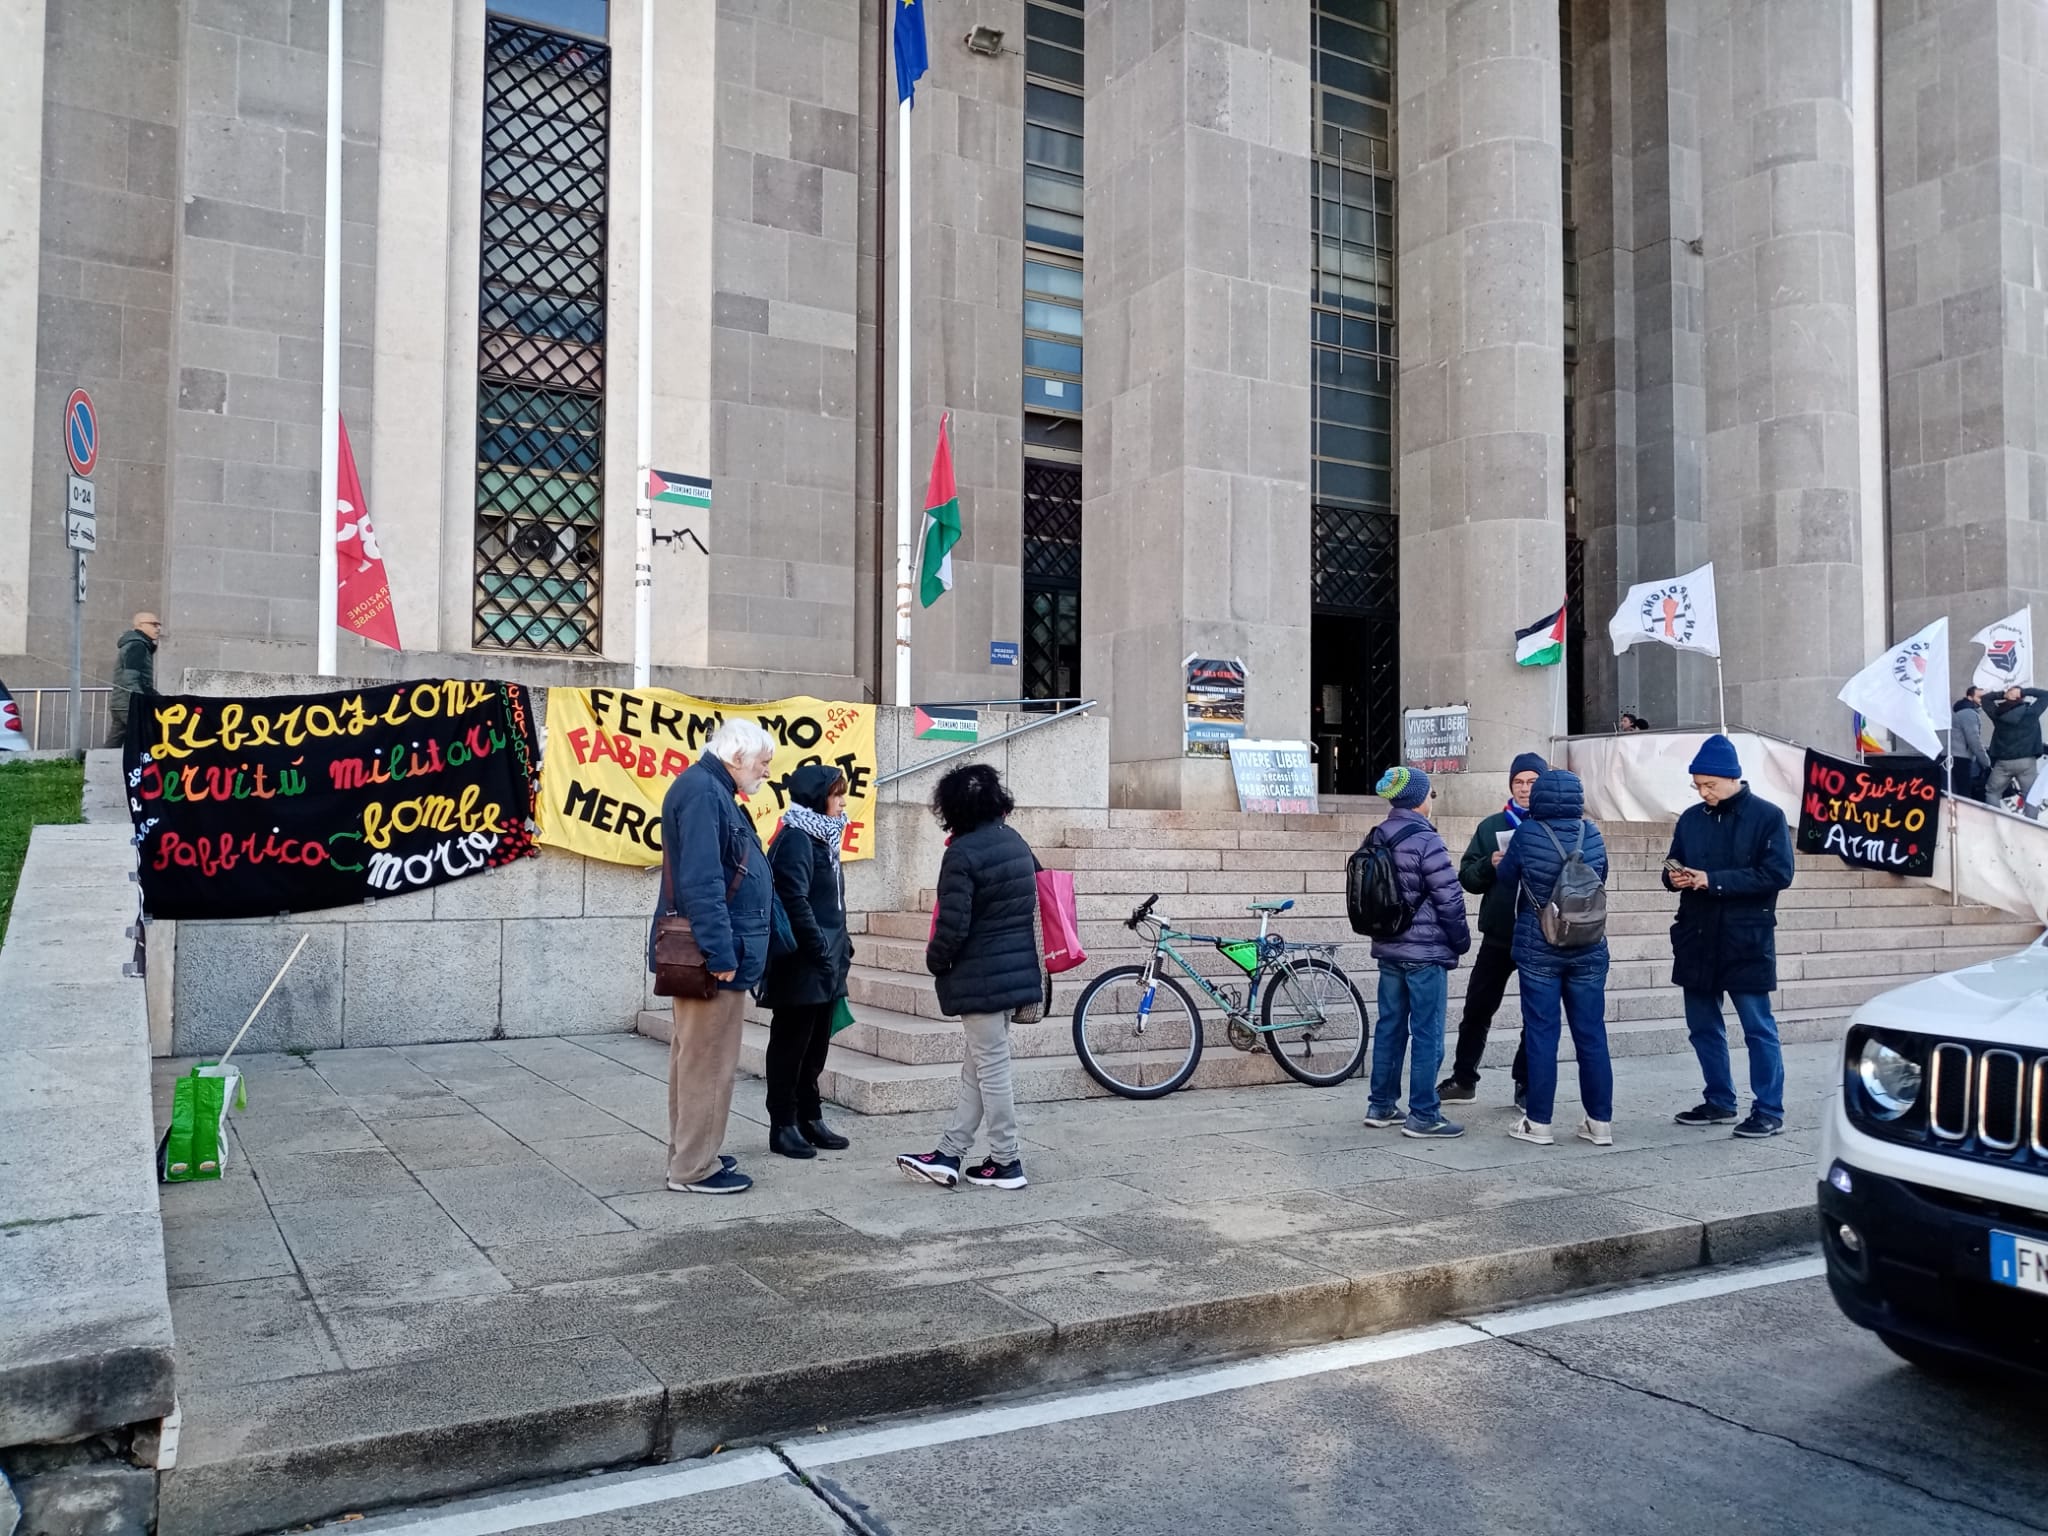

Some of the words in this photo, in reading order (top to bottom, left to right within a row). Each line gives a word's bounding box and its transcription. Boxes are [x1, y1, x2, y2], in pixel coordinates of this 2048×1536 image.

[590, 688, 822, 750] FERMMO
[825, 709, 859, 744] RWM
[329, 720, 506, 790] militari
[1235, 752, 1271, 768] VIVERE
[1275, 752, 1309, 769] LIBERI
[1810, 762, 1846, 795] NO
[364, 784, 507, 849] bombe
[1805, 791, 1829, 822] NO
[366, 831, 498, 890] morte
